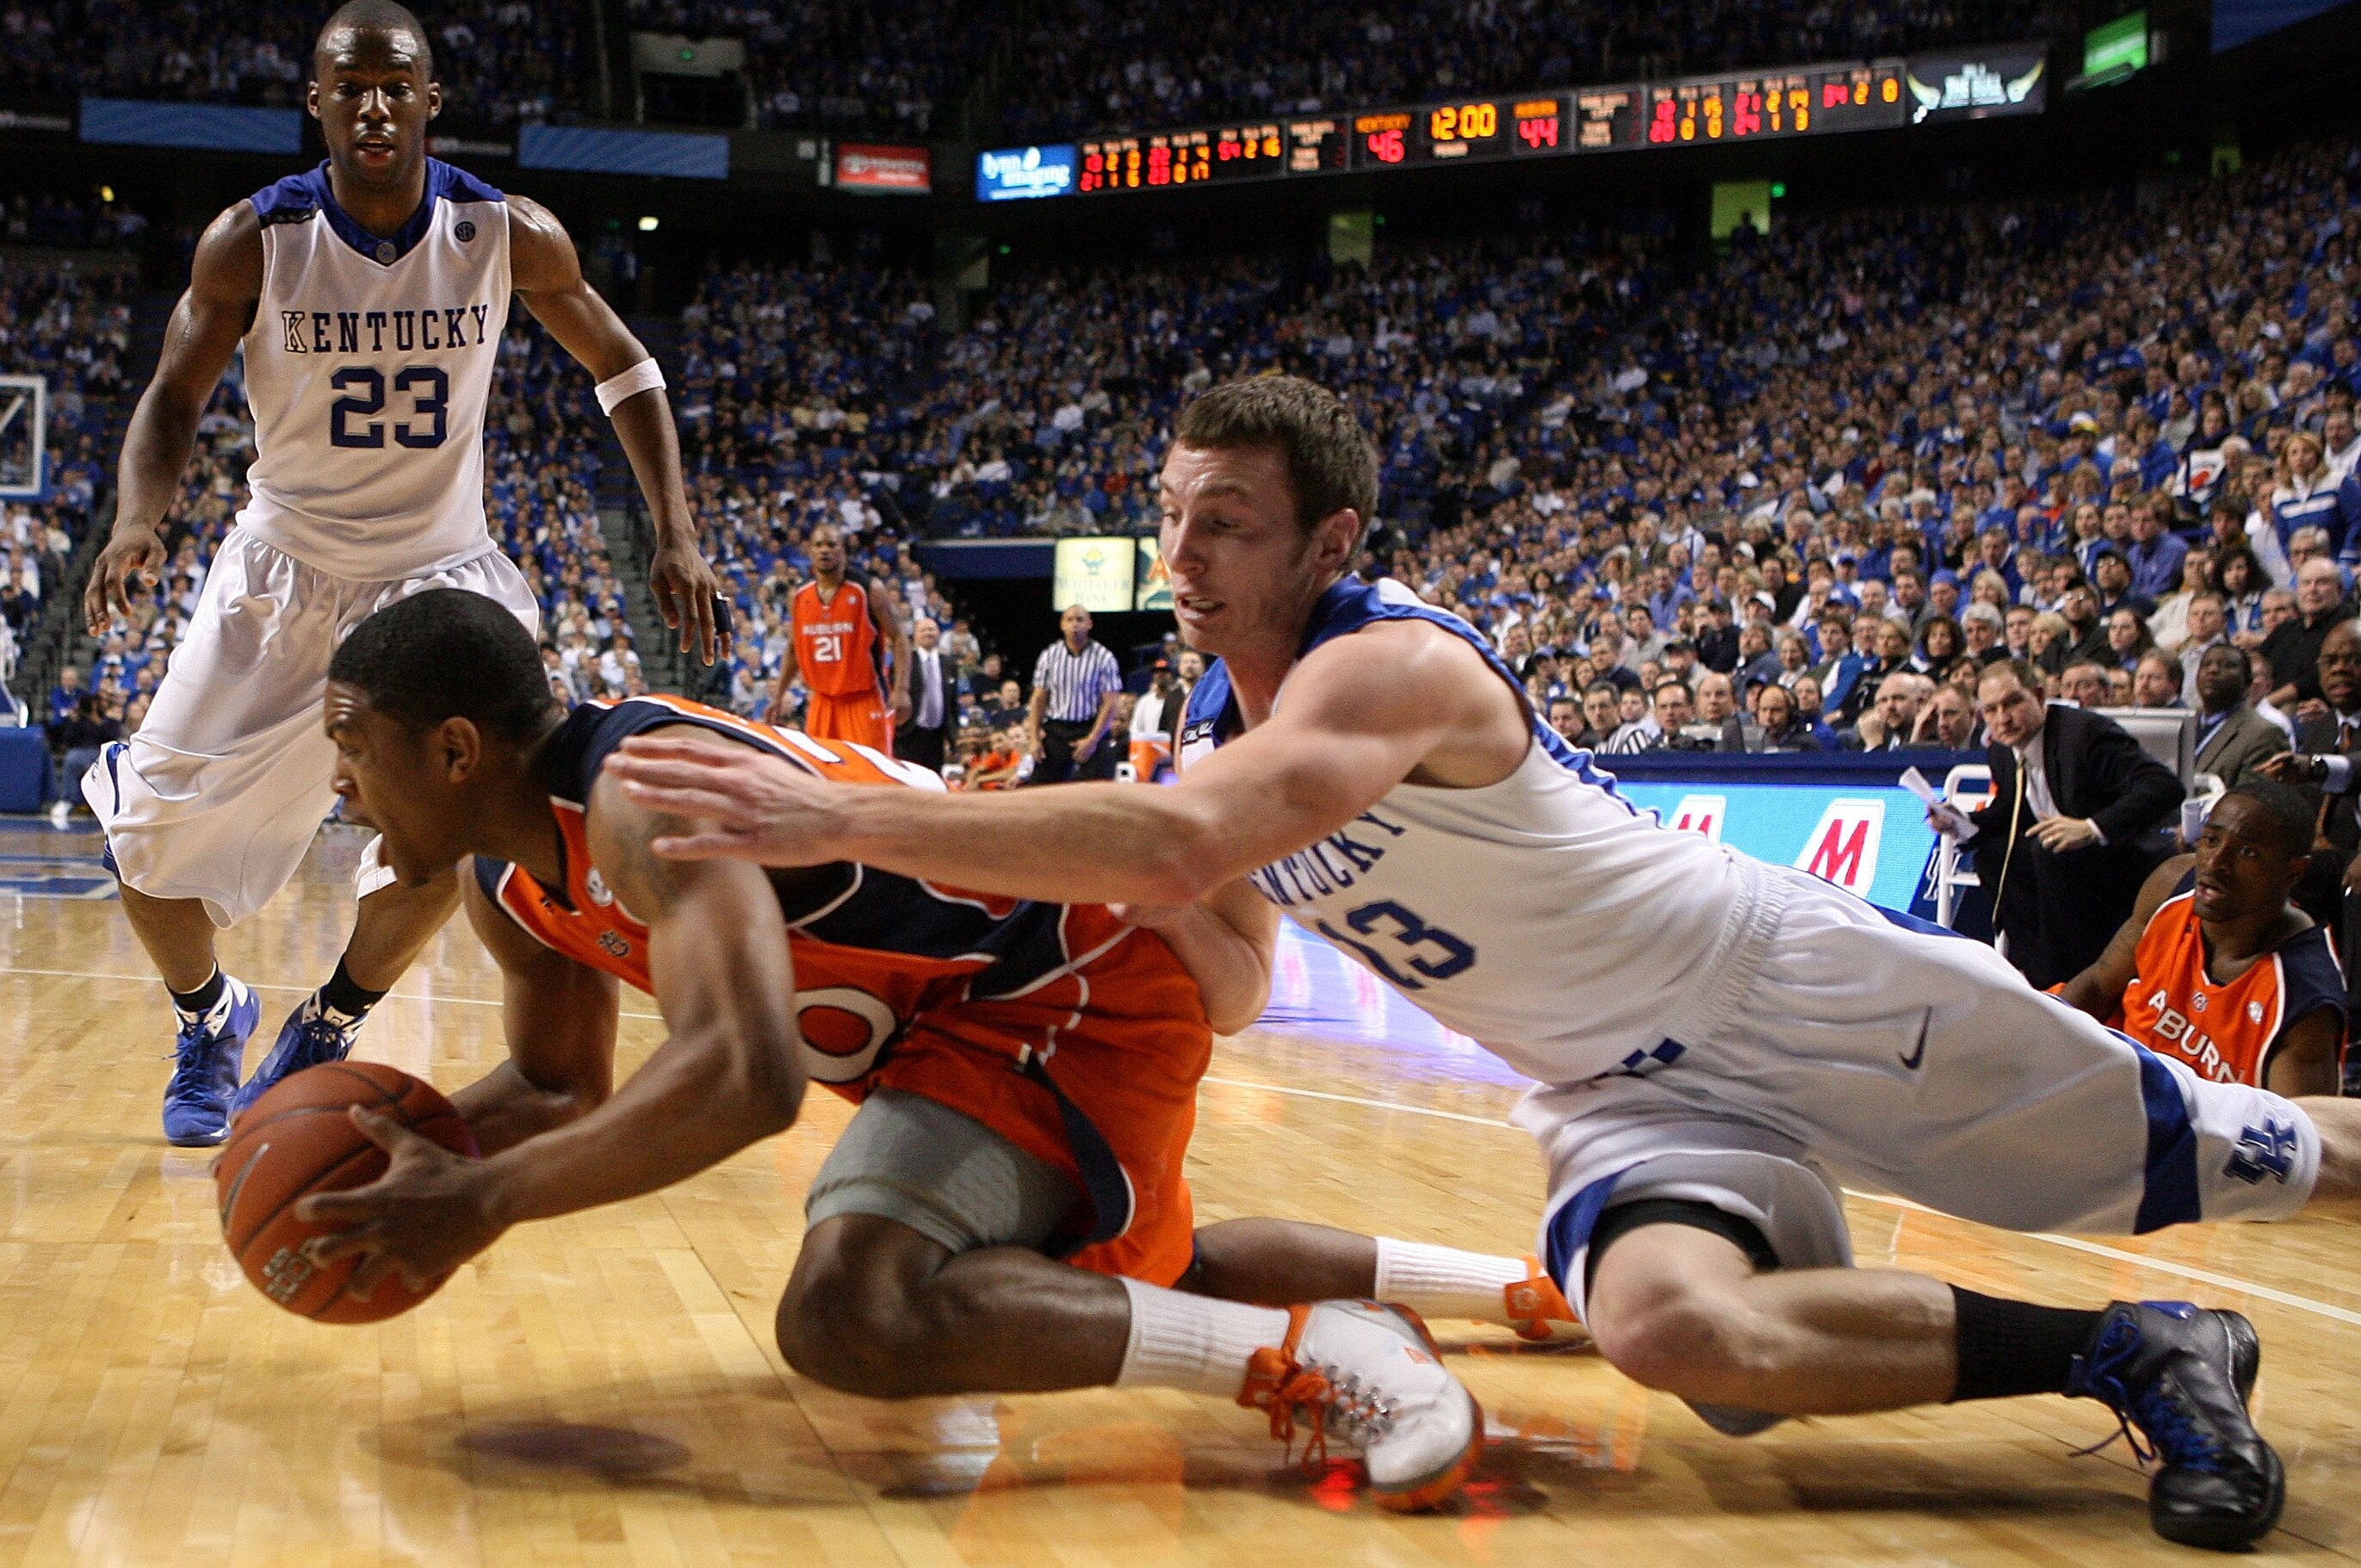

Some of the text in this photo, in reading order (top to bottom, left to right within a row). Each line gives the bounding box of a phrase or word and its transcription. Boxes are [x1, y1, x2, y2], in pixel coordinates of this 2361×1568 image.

[1368, 129, 1405, 163] 46
[1519, 118, 1558, 148] 44
[282, 305, 487, 353] KENTUCKY
[331, 364, 449, 449] 23
[814, 636, 842, 662] 21
[1317, 900, 1476, 990] 13
